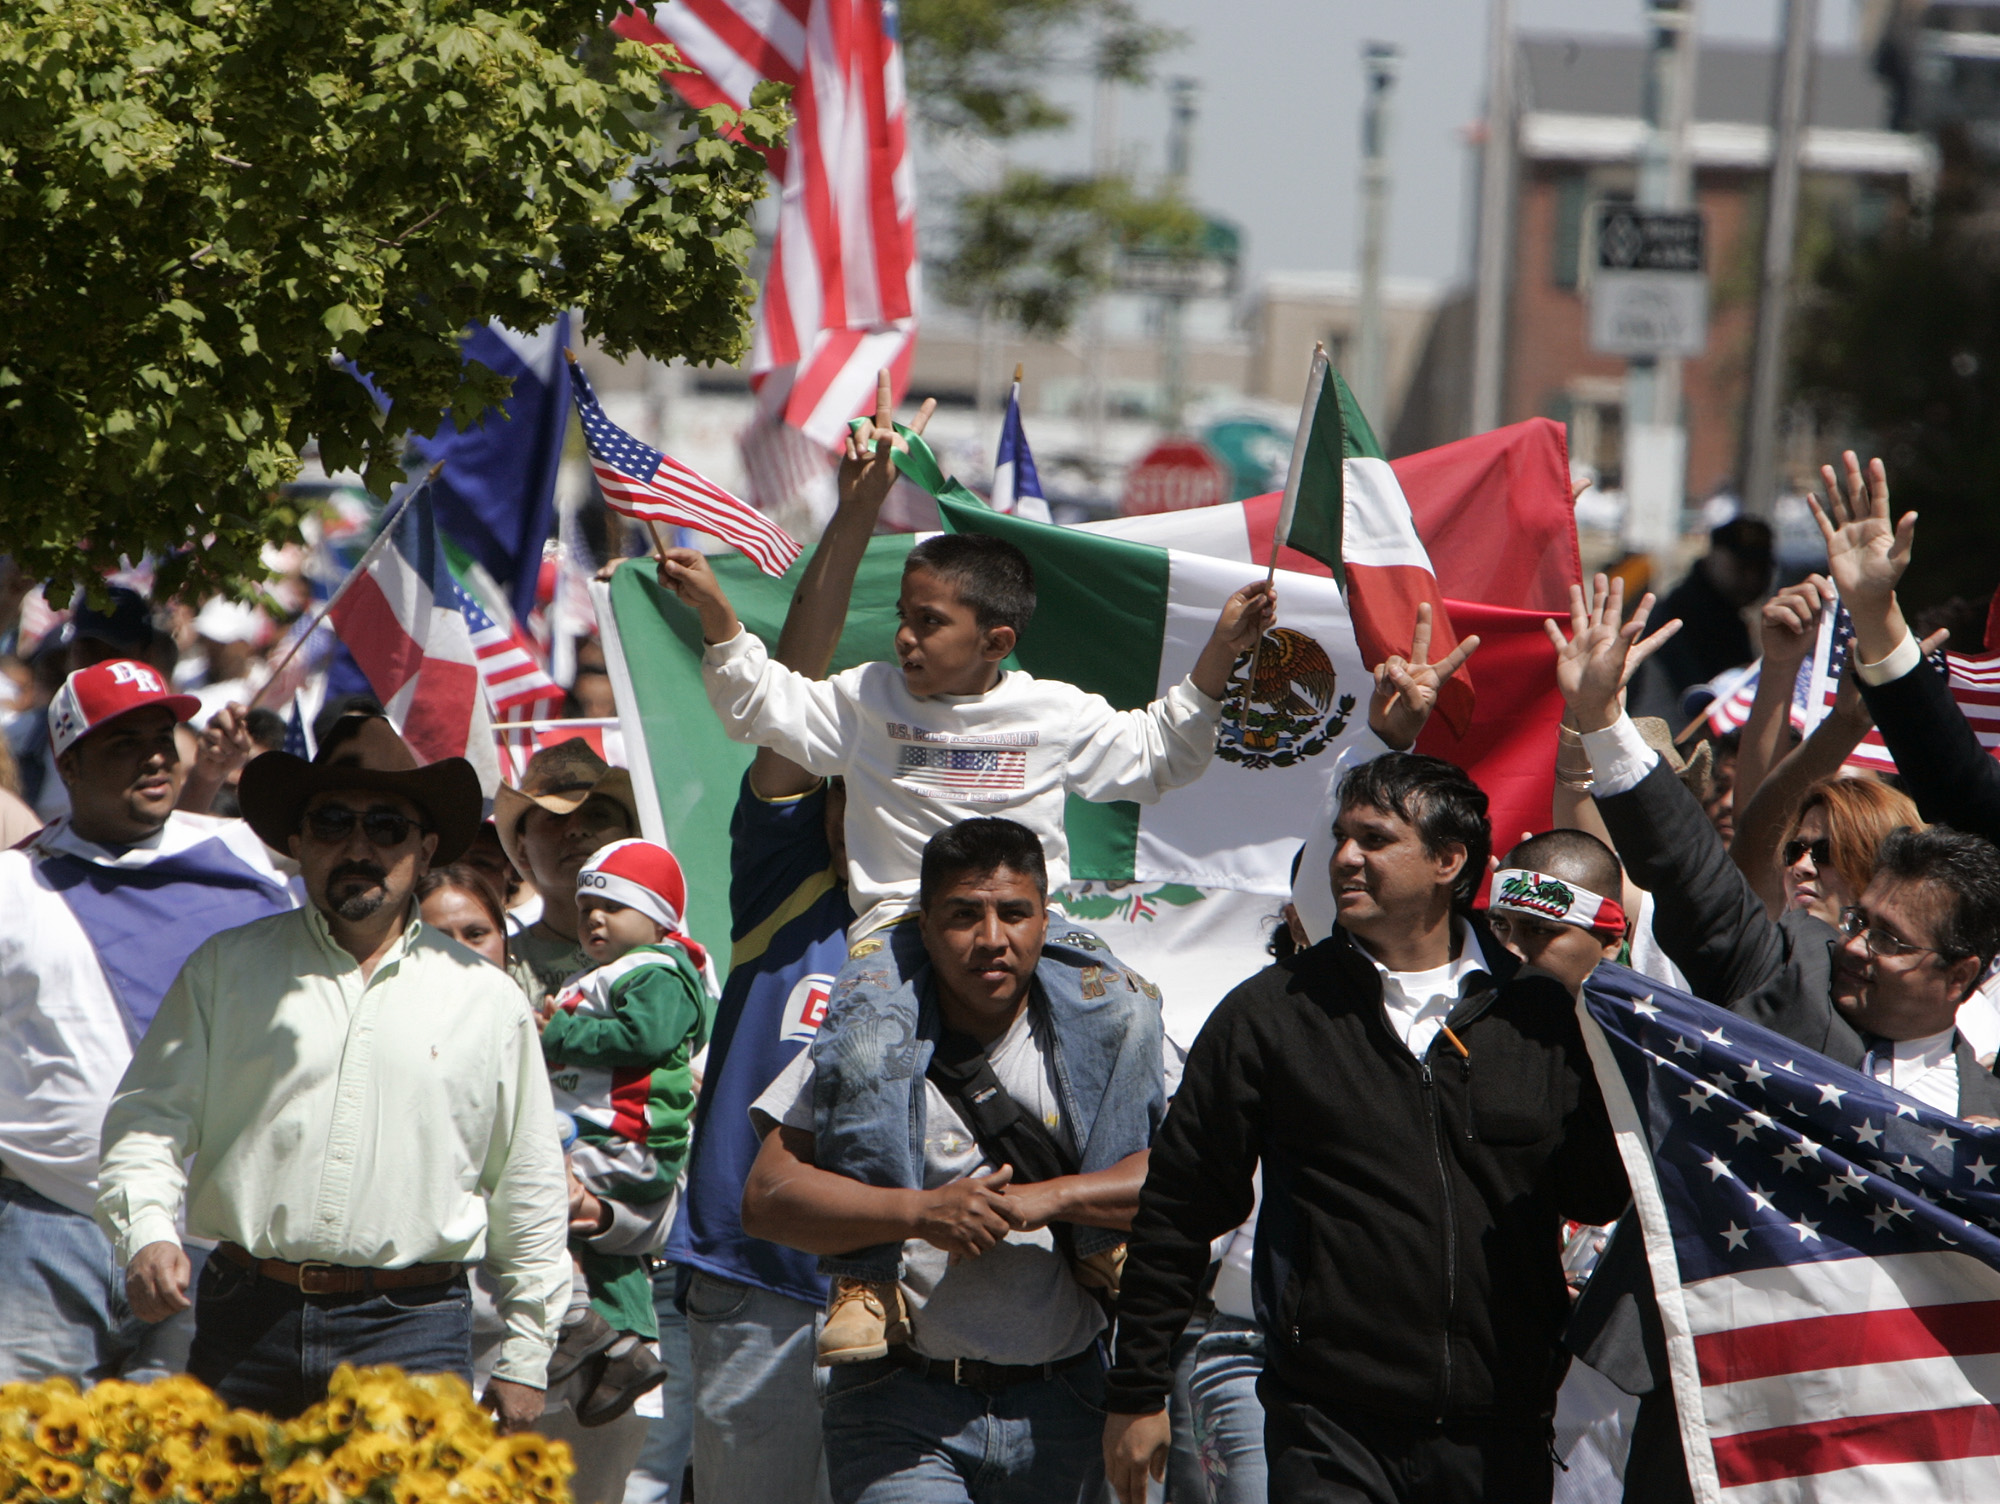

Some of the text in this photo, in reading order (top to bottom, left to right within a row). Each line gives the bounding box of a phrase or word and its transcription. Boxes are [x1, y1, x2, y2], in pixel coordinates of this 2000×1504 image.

[105, 661, 162, 692] DR
[886, 722, 911, 740] U.S.
[949, 731, 1040, 747] ASSOCIATION
